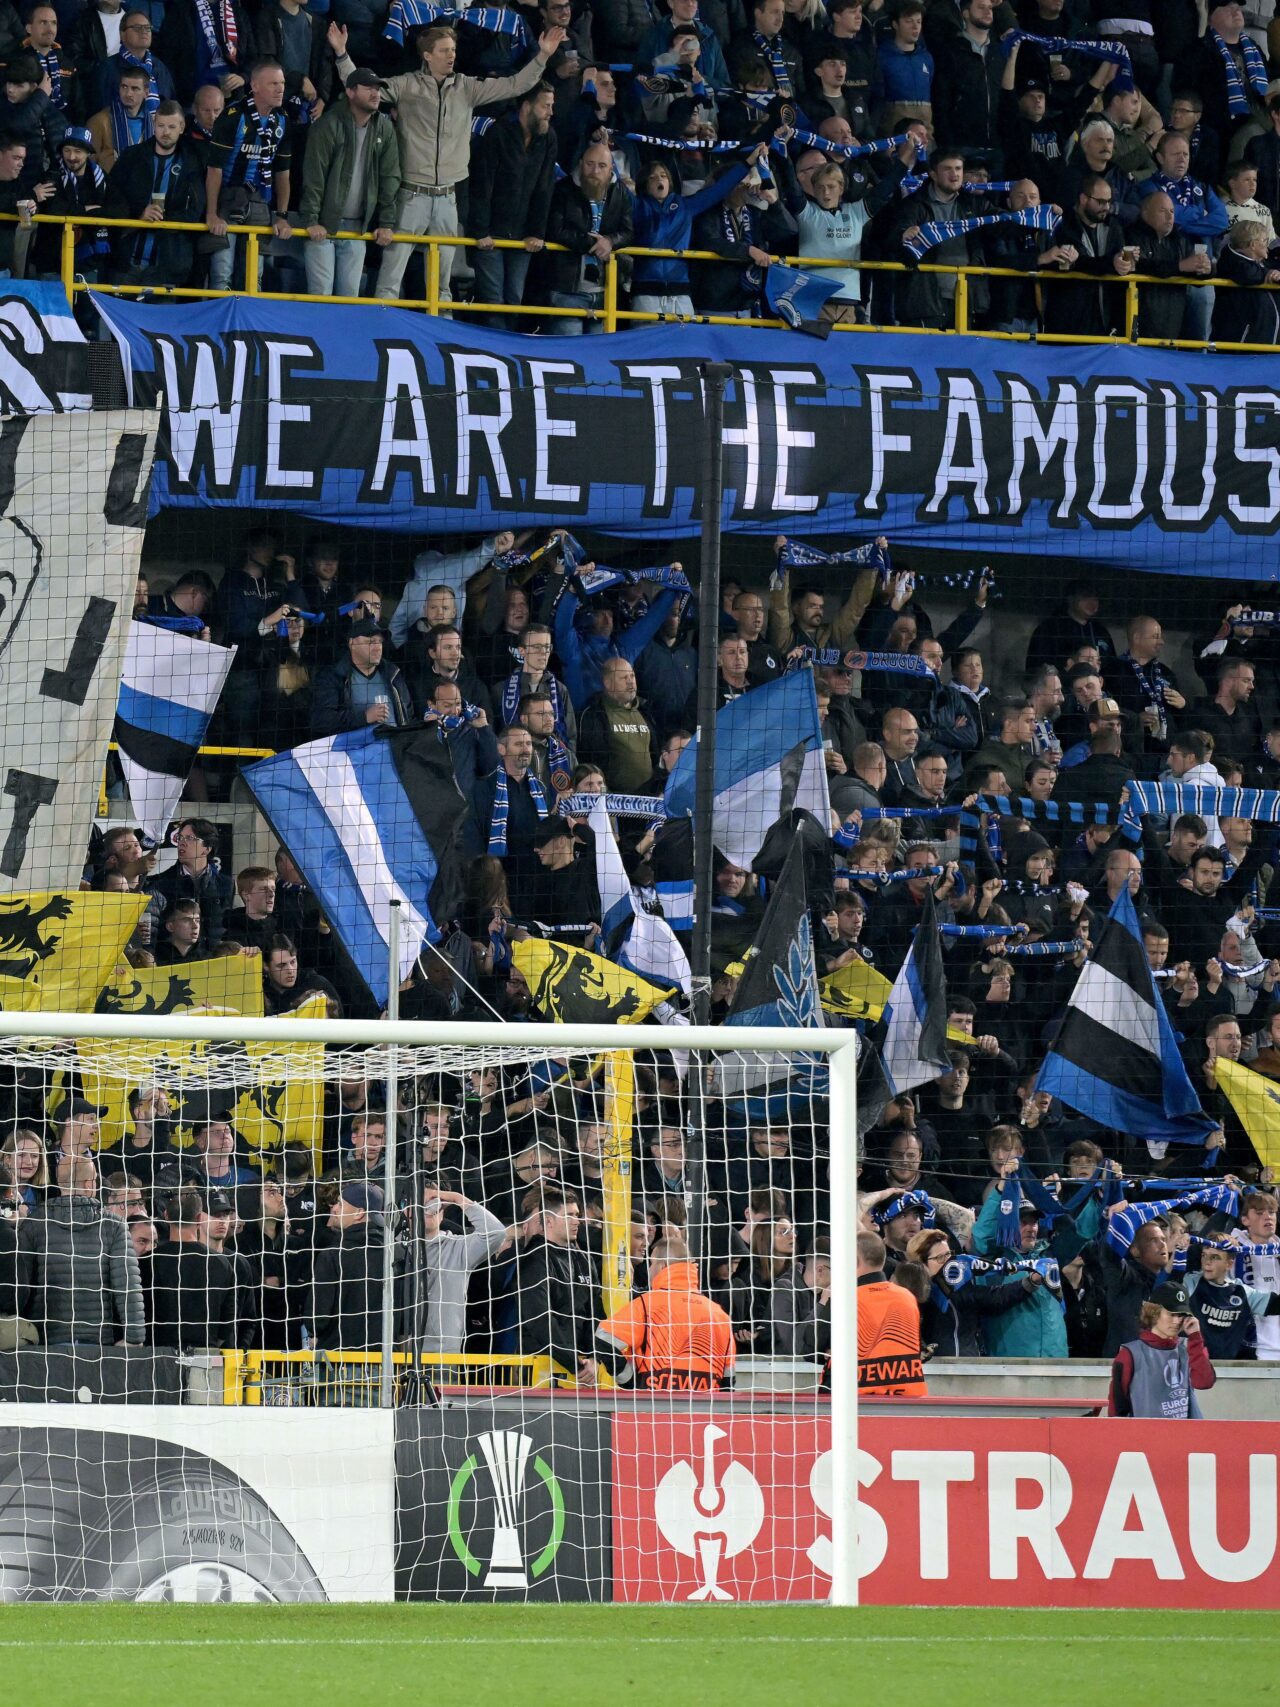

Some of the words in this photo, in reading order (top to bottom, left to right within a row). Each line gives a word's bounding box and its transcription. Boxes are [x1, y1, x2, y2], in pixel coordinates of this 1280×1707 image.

[154, 336, 315, 488] WE
[370, 347, 581, 503] ARE
[625, 363, 820, 513] THE
[862, 372, 1280, 525] FAMOUS
[1232, 611, 1274, 622] LUB
[504, 674, 521, 710] CLUB
[1201, 1303, 1242, 1321] UNIBET
[857, 1358, 924, 1382] TEWAR
[806, 1448, 1280, 1583] STRAU
